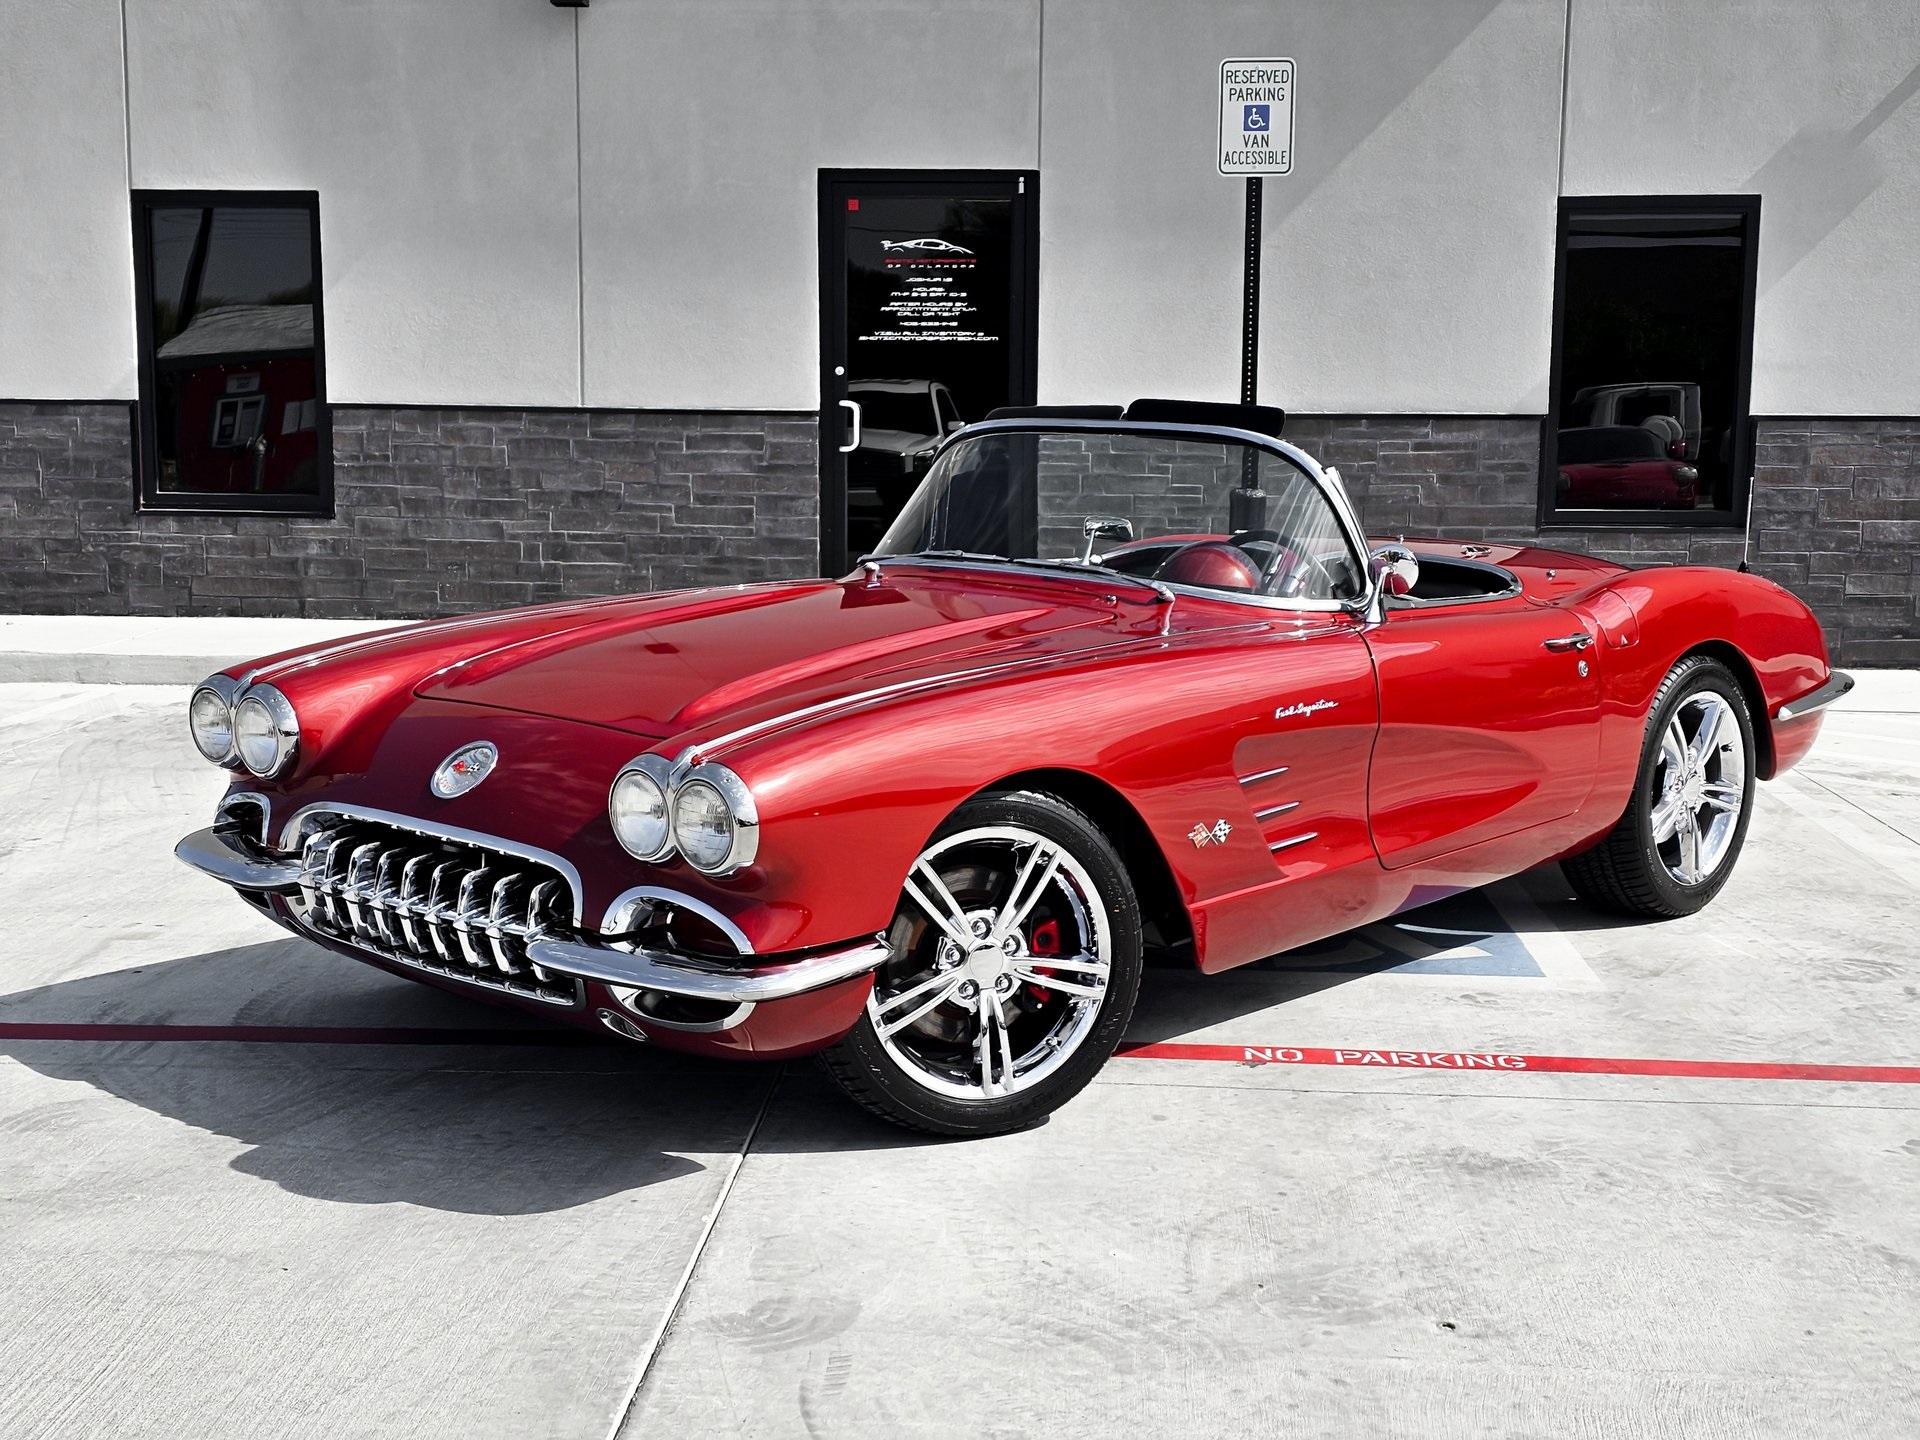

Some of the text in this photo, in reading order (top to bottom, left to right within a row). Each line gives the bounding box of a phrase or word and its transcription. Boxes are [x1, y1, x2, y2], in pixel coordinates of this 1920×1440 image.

[1225, 69, 1290, 84] RESERVED
[1229, 87, 1285, 102] PARKING
[1242, 134, 1270, 148] VAN
[1223, 150, 1287, 165] ACCESSIBLE
[1274, 705, 1296, 720] Fuel
[1243, 1046, 1528, 1070] NO PARKING
